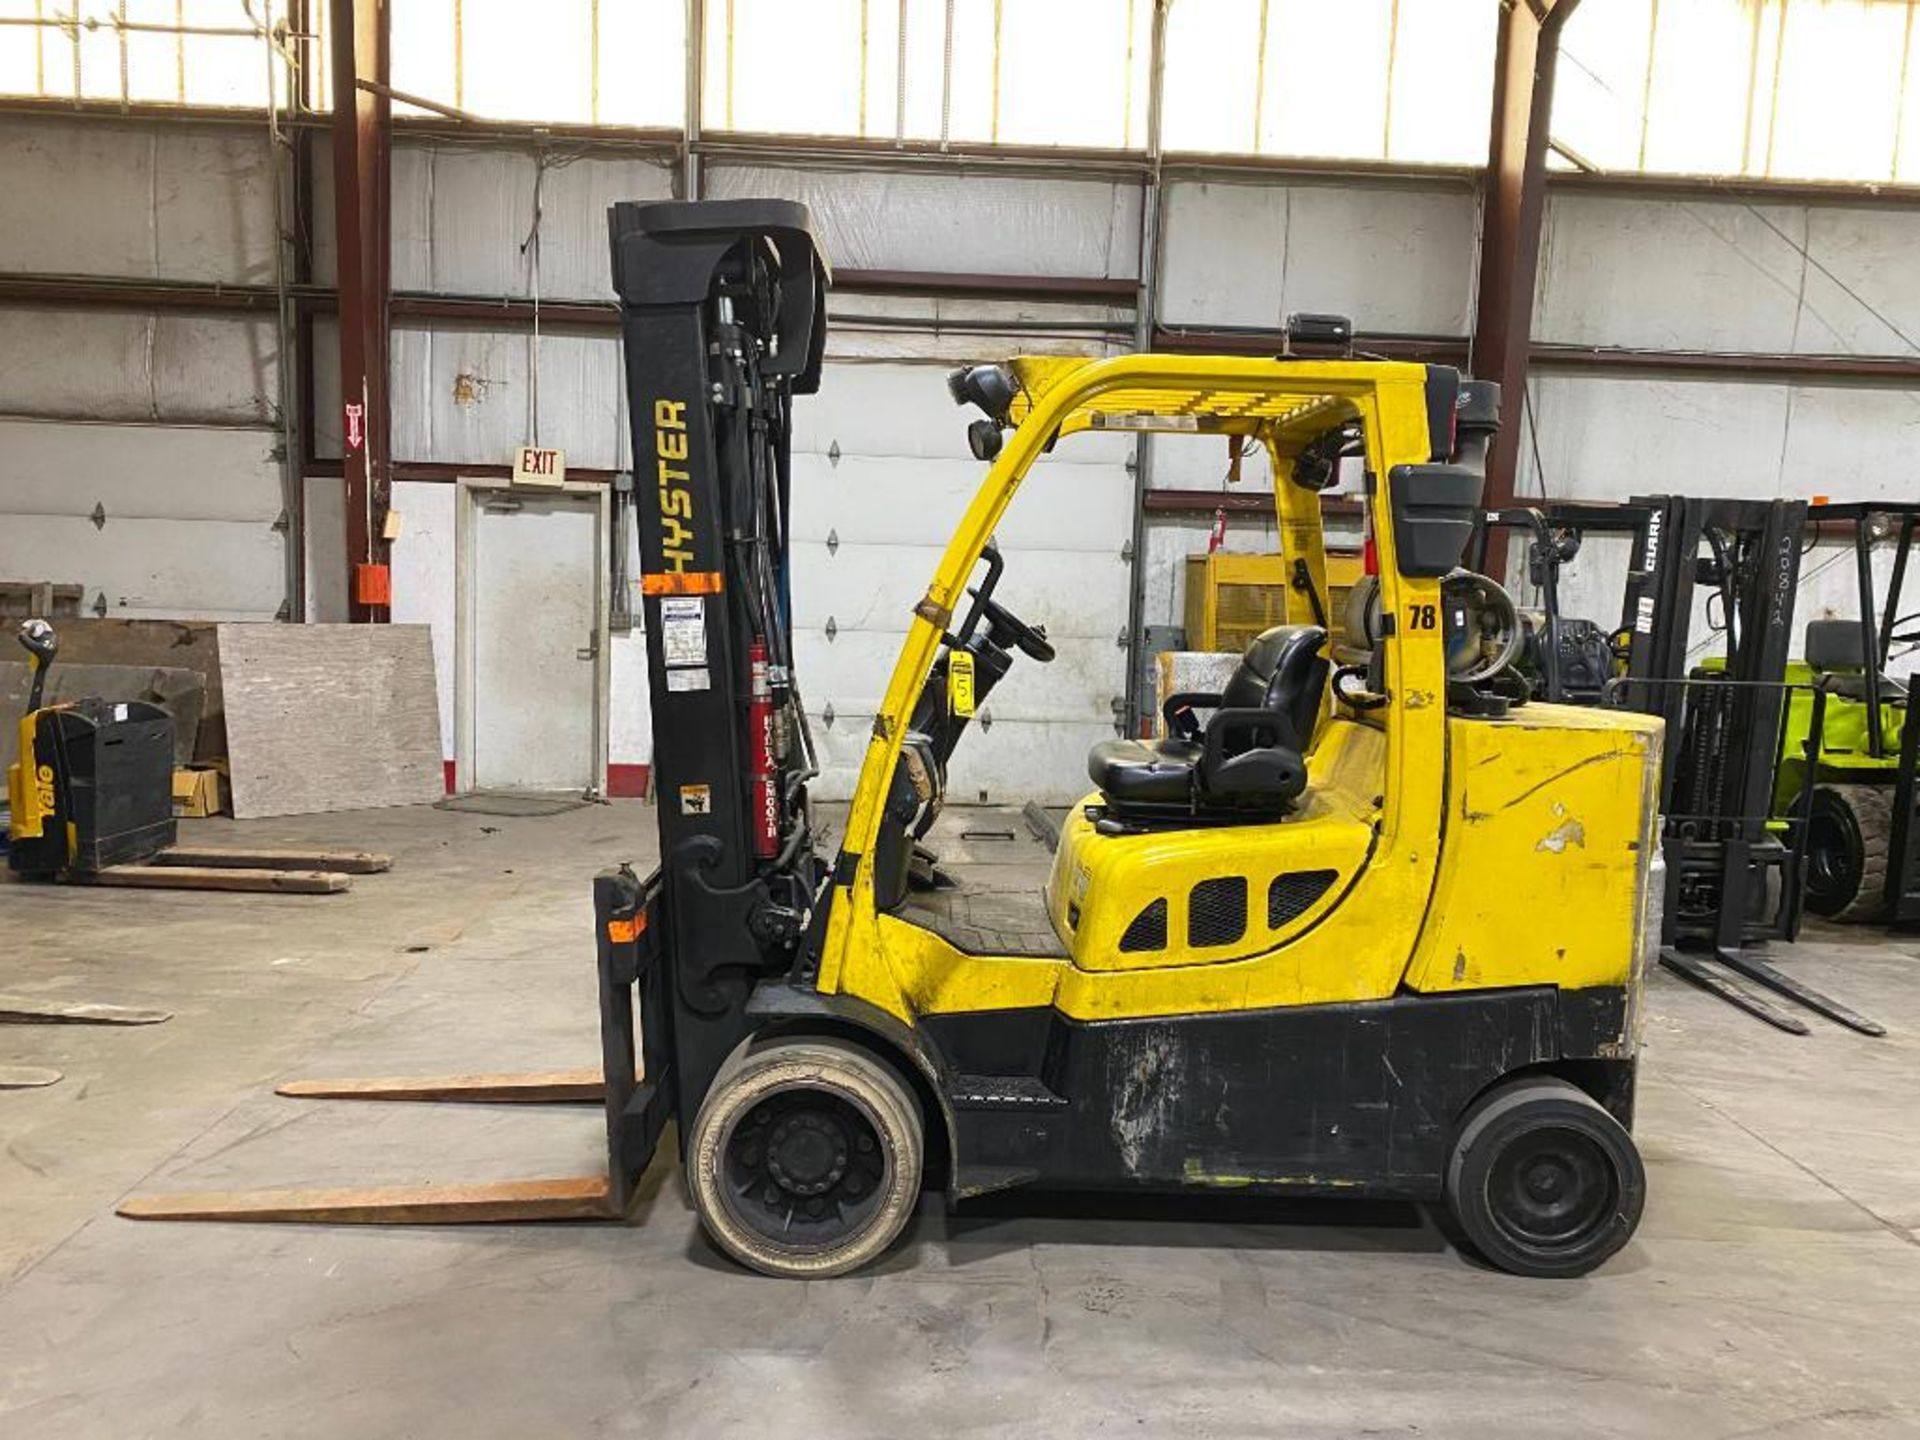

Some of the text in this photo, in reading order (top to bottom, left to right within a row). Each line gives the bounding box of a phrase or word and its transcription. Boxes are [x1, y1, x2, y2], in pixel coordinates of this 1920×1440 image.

[522, 449, 558, 475] EXIT
[655, 400, 693, 574] HYSTER
[1645, 509, 1662, 571] CLARK
[1409, 605, 1436, 630] 78
[38, 766, 54, 816] Yale
